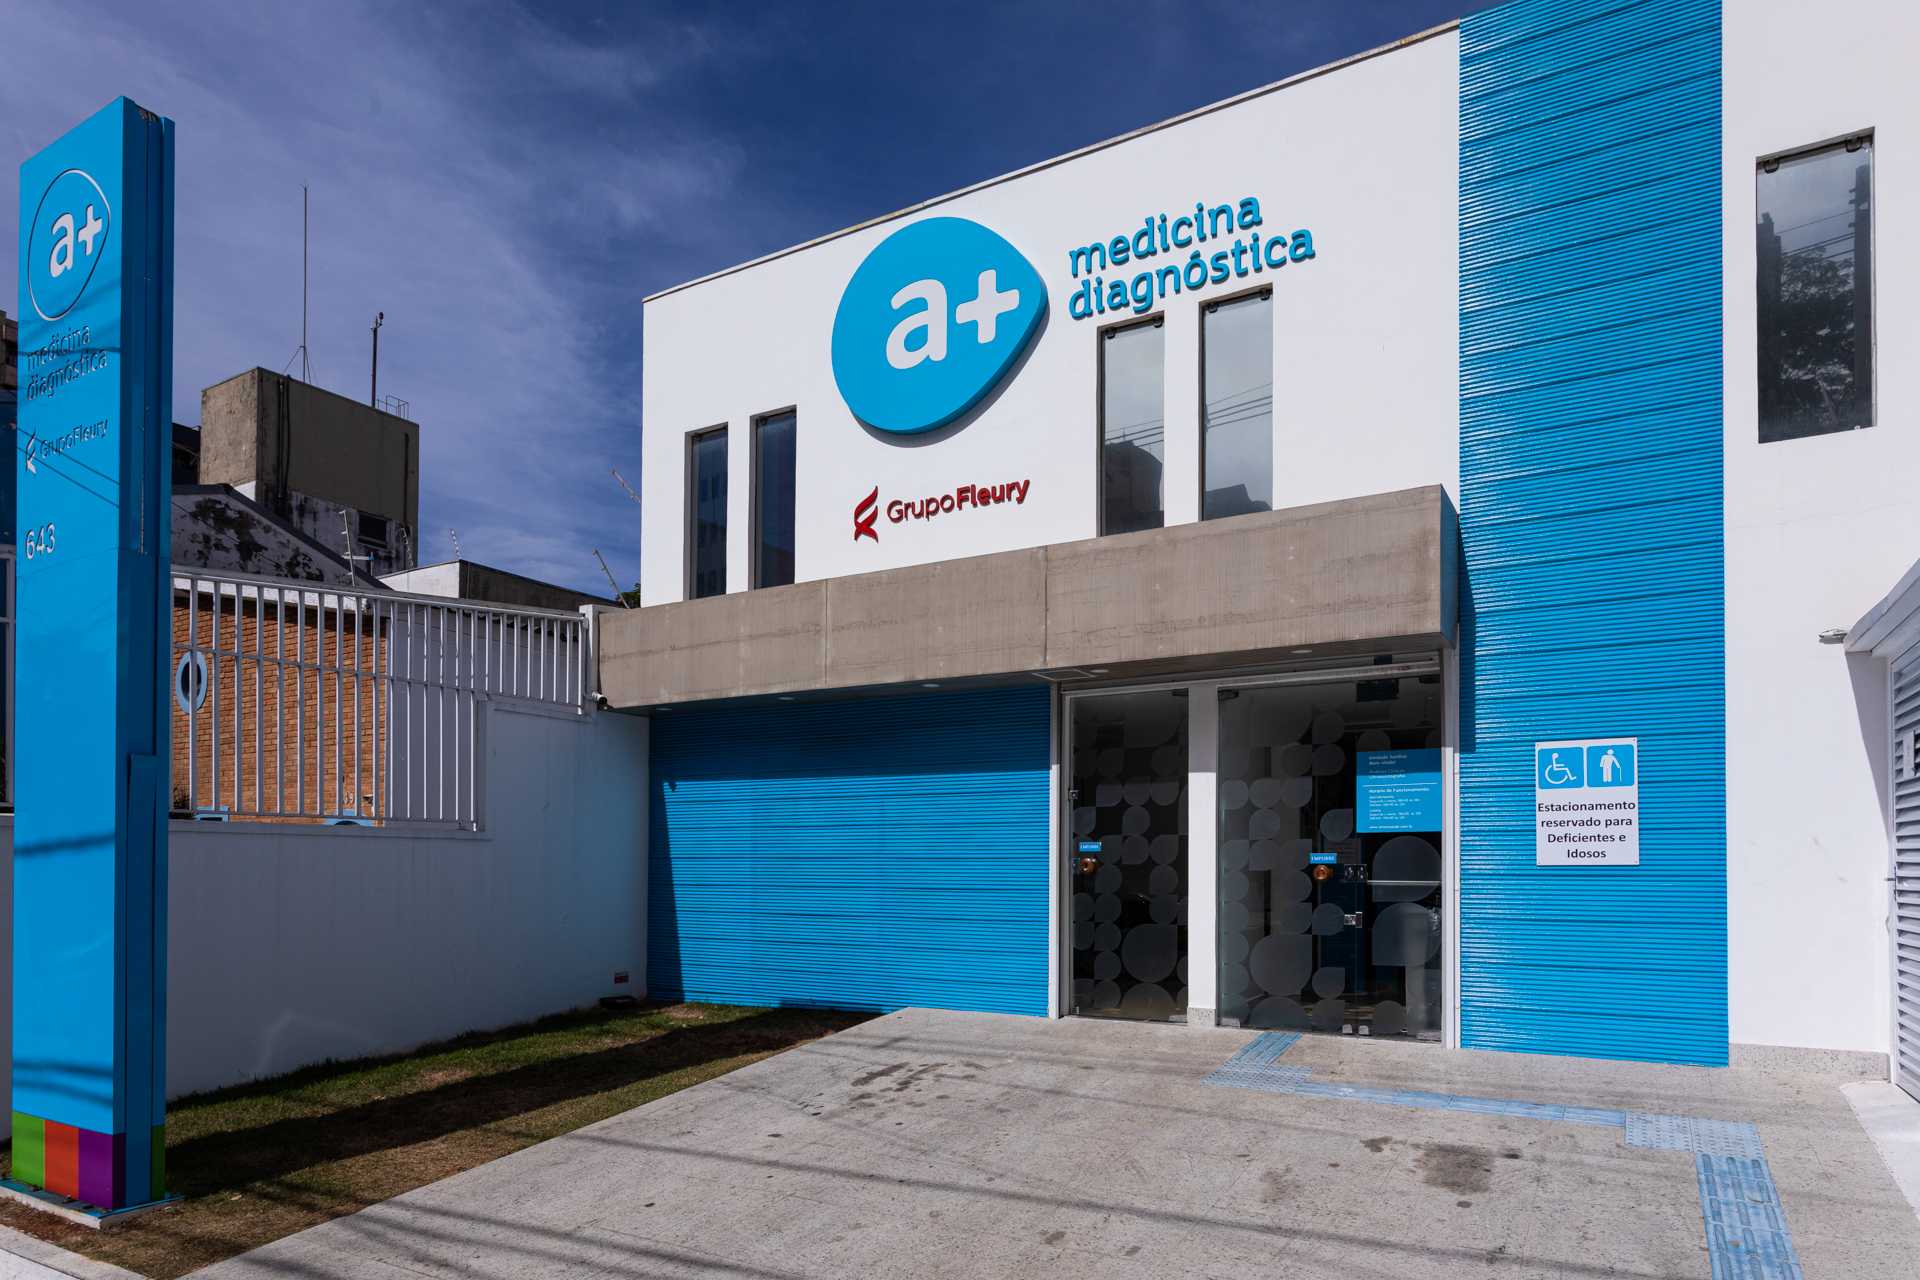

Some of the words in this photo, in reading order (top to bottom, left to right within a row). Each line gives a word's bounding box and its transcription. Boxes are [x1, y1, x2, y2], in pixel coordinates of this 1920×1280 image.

[50, 203, 103, 278] a+
[1069, 197, 1263, 278] medicina
[1068, 229, 1316, 319] diagnóstica
[886, 269, 1020, 370] a+
[26, 324, 90, 371] medicina
[27, 349, 107, 401] diagnóstica
[887, 479, 1031, 524] GrupoFleury
[25, 522, 56, 560] 643
[1537, 801, 1636, 812] Estacionamento
[1540, 816, 1601, 828] reservado
[1605, 818, 1633, 829] para
[1547, 832, 1616, 843] Deficientes
[1619, 834, 1627, 842] e
[1566, 848, 1607, 859] Idosos
